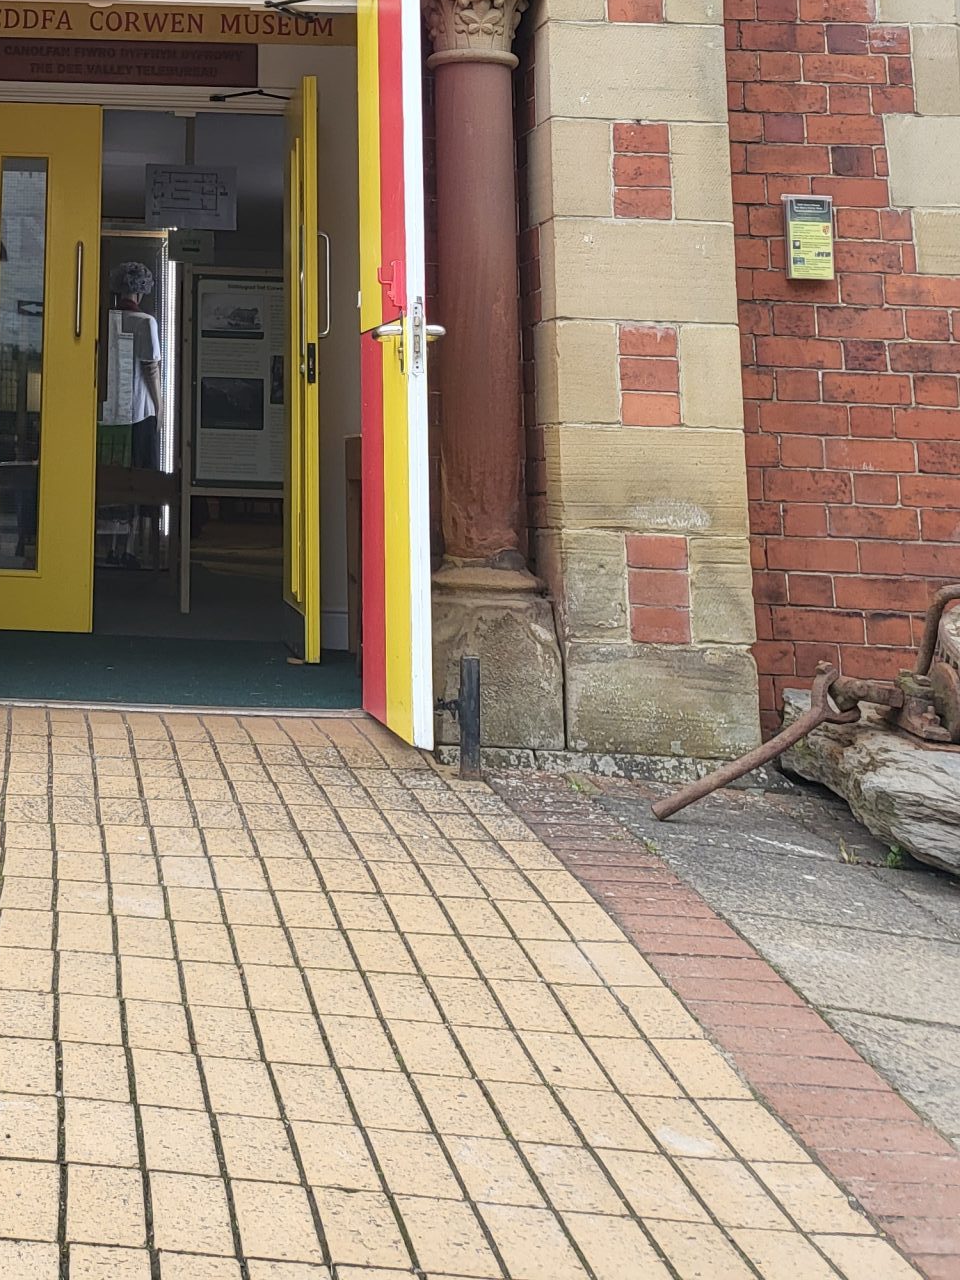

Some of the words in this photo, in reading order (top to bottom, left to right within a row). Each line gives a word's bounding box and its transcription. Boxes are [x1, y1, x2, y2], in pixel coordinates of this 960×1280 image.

[89, 10, 204, 34] CORWEN
[220, 13, 334, 37] MUSEUM
[30, 62, 53, 74] THE
[56, 62, 83, 75] DEE
[86, 63, 133, 76] VALLEY
